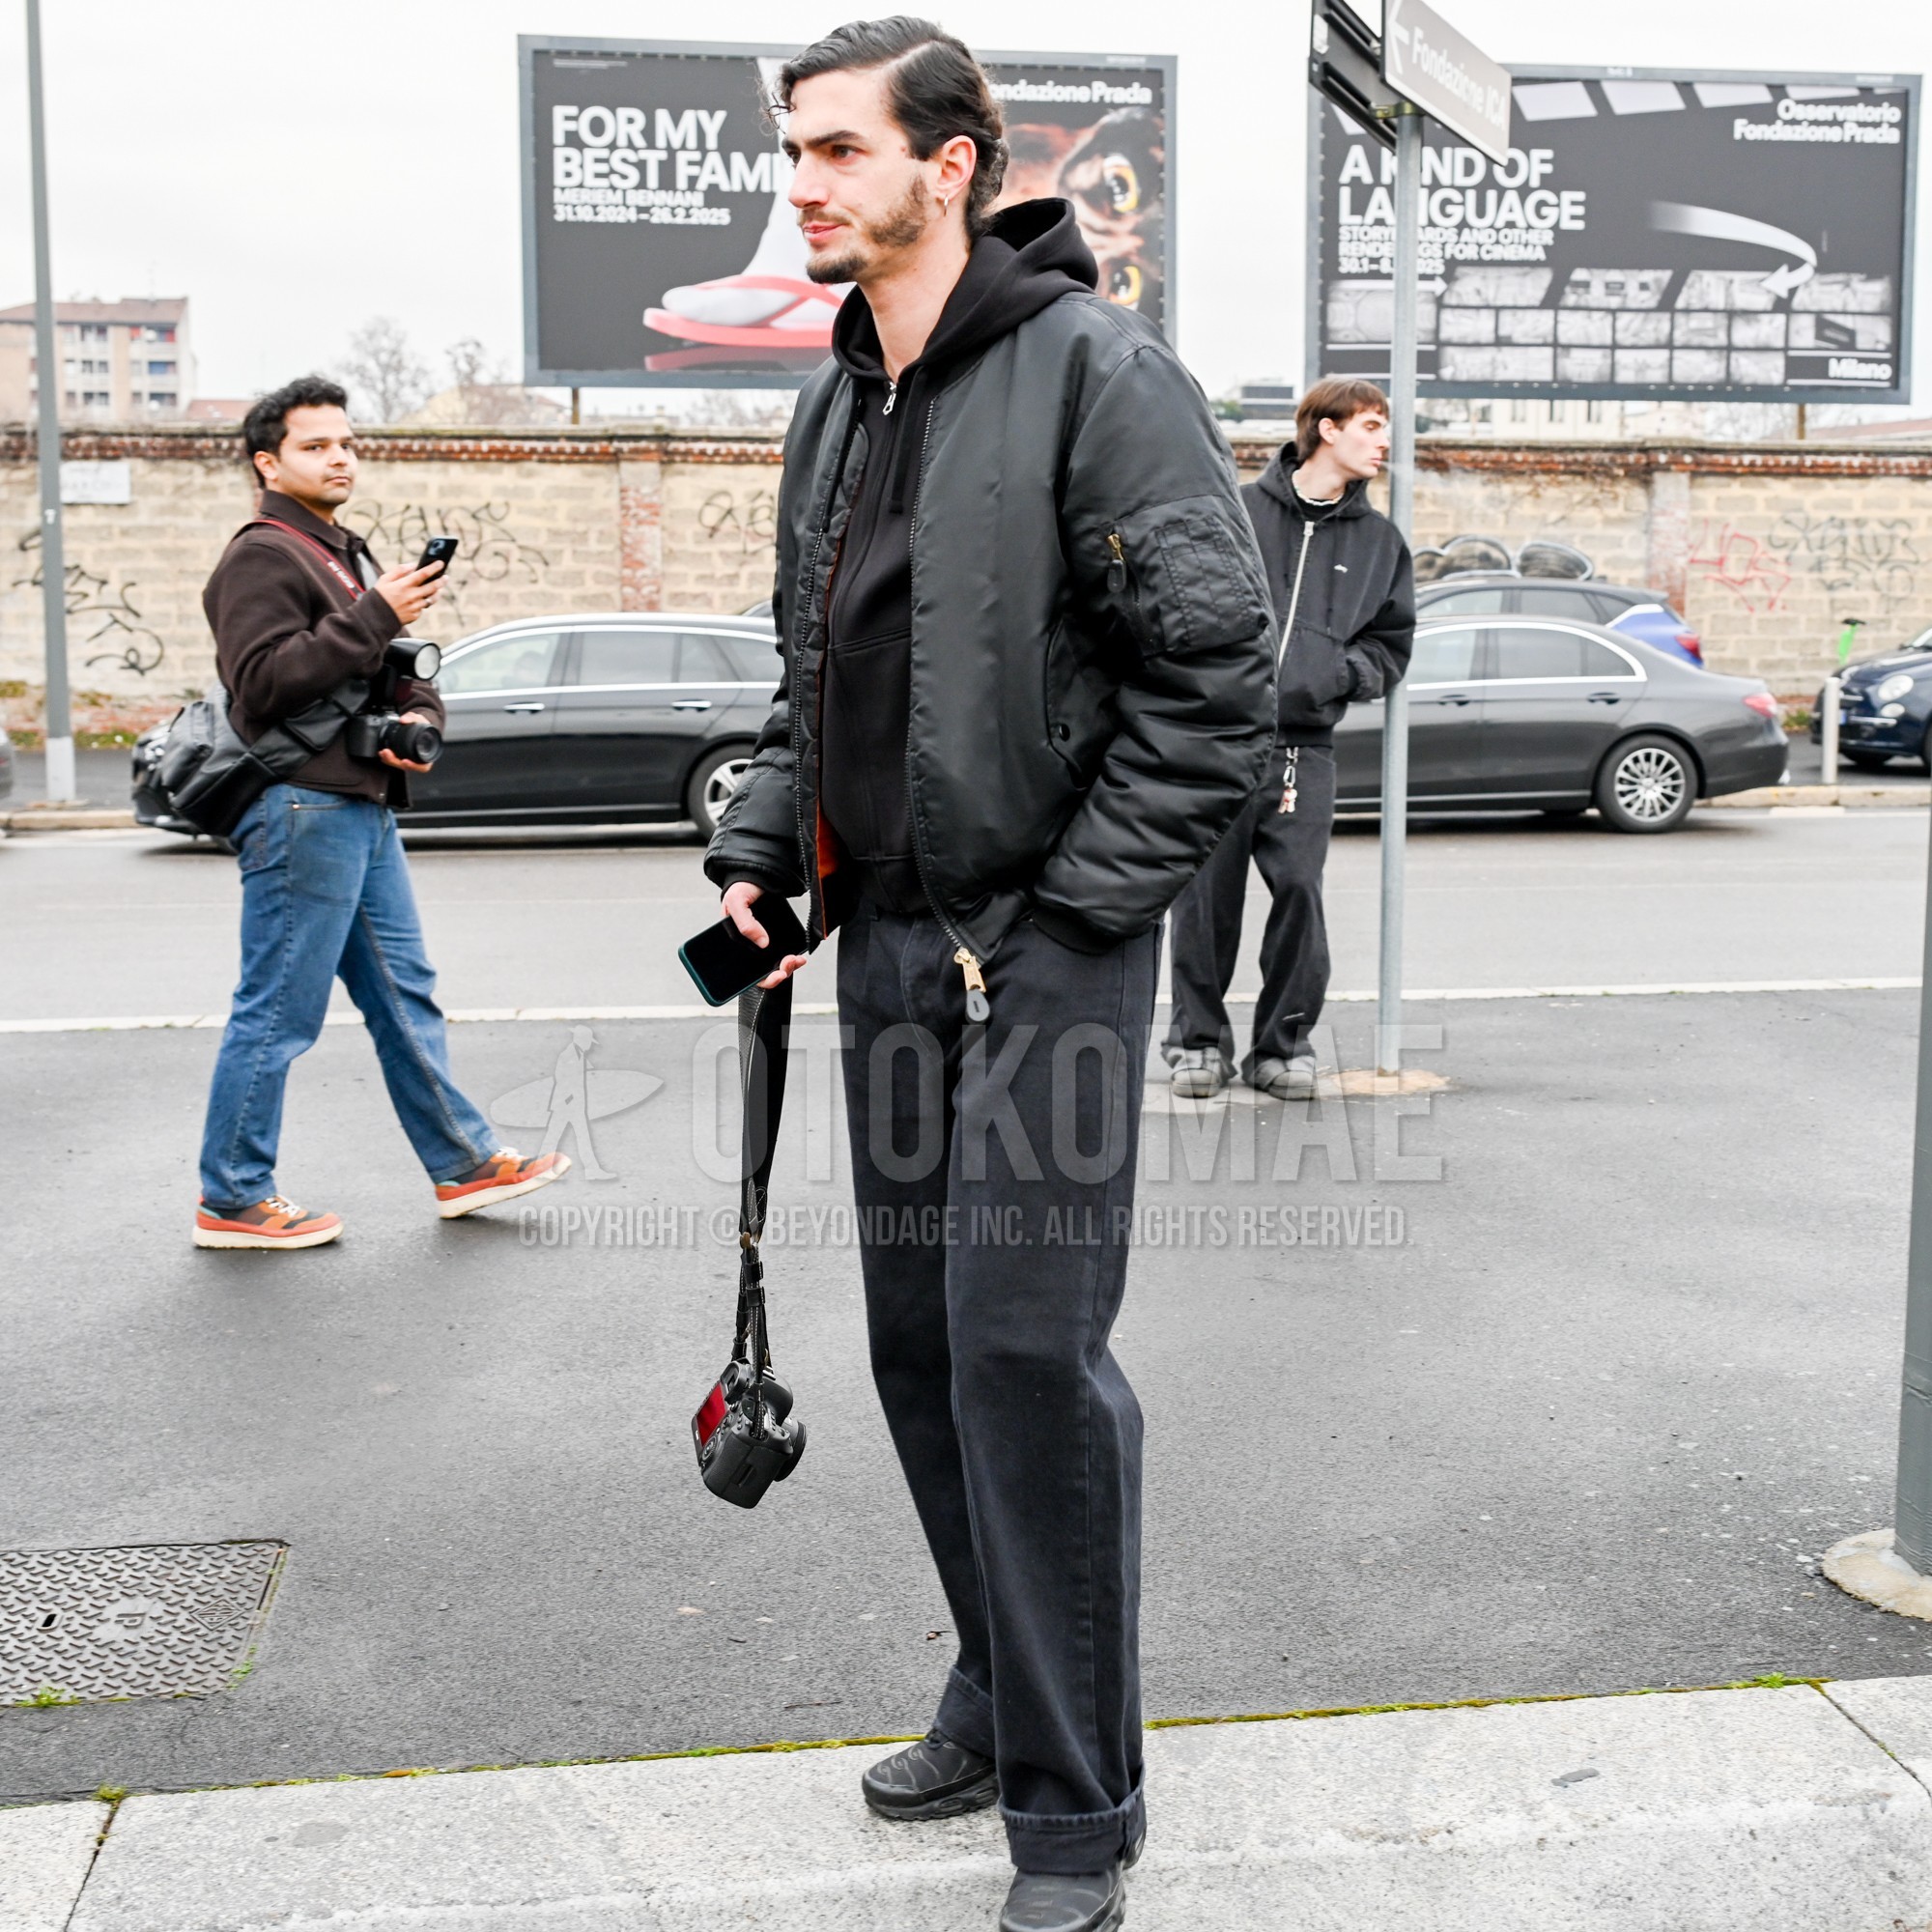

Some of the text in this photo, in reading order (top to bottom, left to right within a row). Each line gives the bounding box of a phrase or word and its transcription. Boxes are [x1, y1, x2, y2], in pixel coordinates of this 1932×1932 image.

[986, 78, 1152, 104] ondazione Prada
[1411, 25, 1507, 132] Fondazione ICA
[1776, 99, 1901, 123] Osservatorio
[552, 104, 728, 151] FOR MY
[1733, 118, 1900, 144] Fondazione Prada
[553, 147, 668, 190] BEST
[1338, 144, 1374, 185] A
[1492, 148, 1554, 188] OF
[553, 187, 624, 206] MERIEM
[1459, 228, 1498, 245] AND
[1498, 228, 1555, 246] OTHER
[1443, 243, 1479, 260] FOR
[1479, 243, 1547, 261] CINEMA
[1828, 357, 1892, 381] Milano
